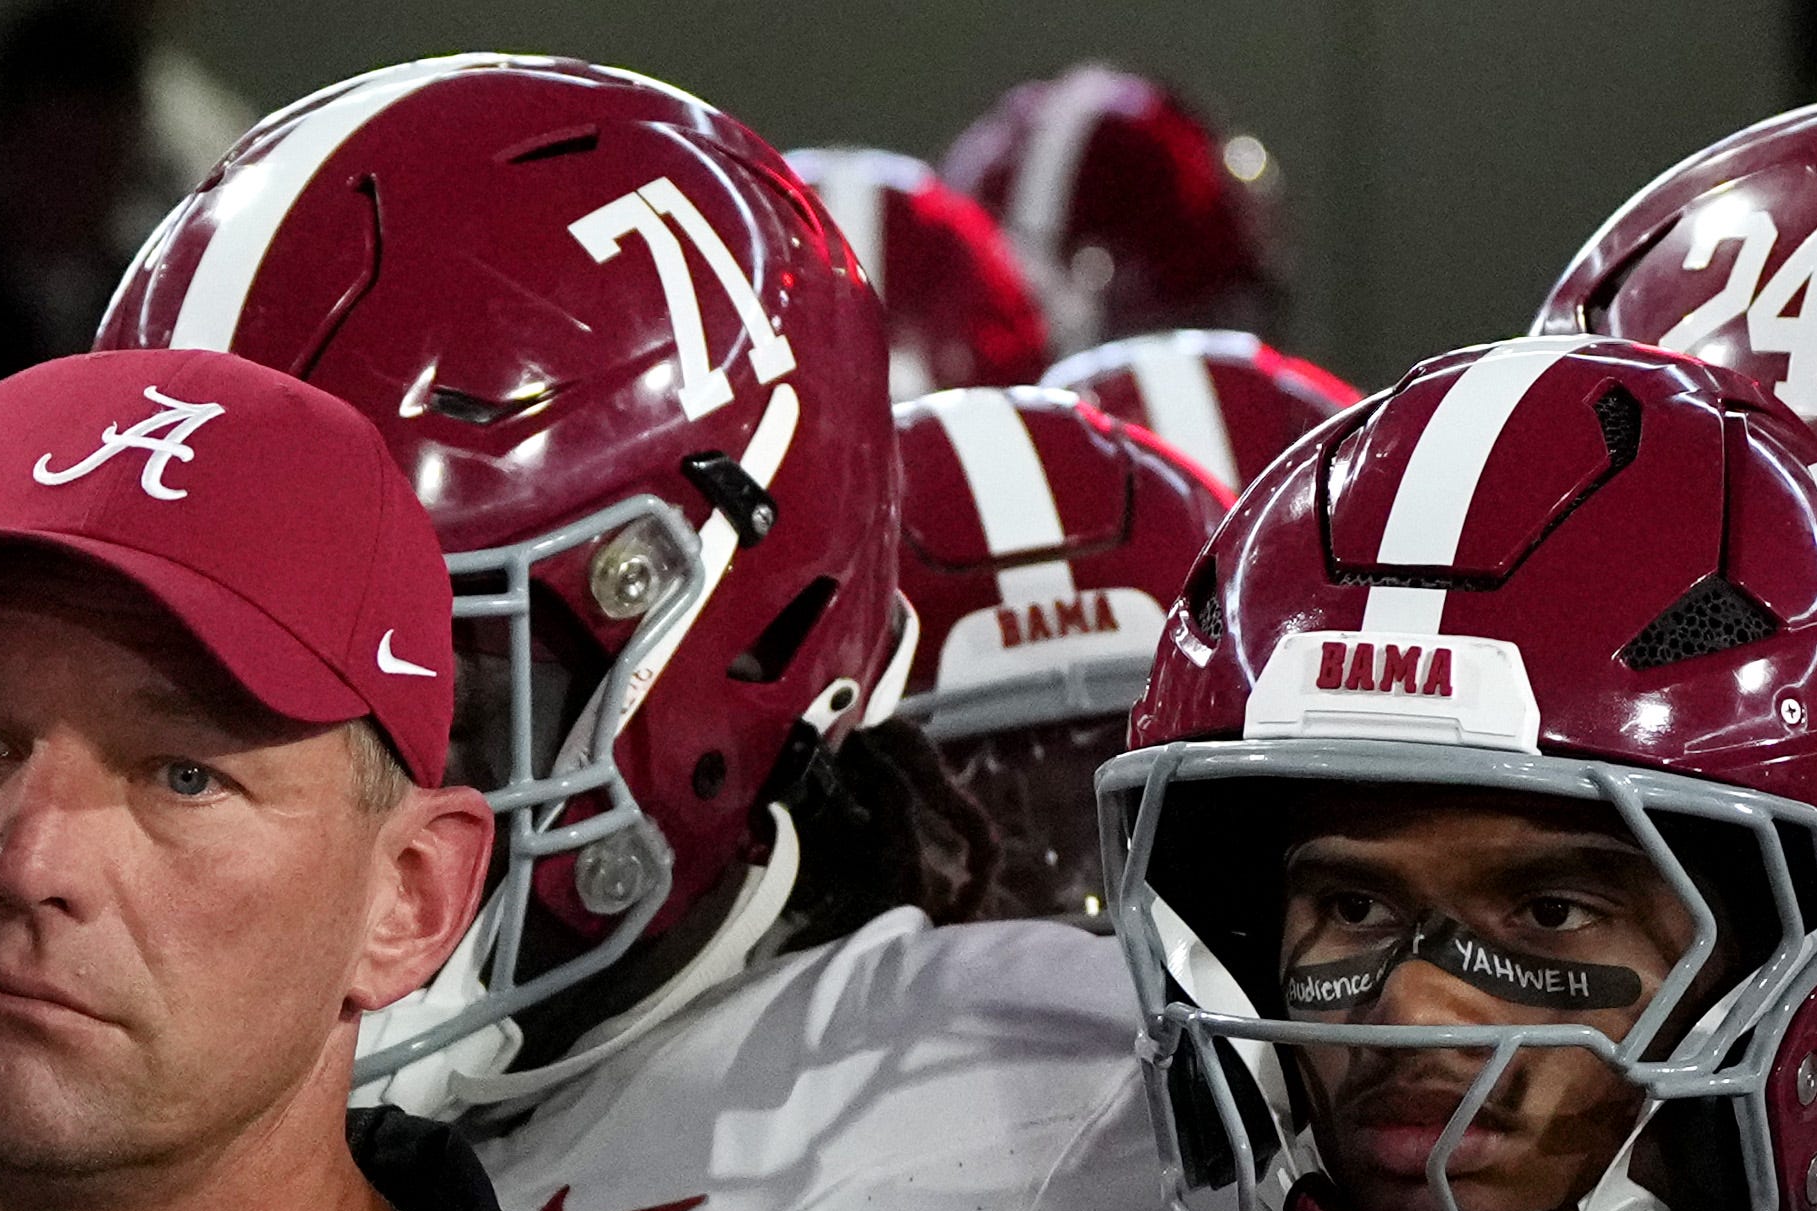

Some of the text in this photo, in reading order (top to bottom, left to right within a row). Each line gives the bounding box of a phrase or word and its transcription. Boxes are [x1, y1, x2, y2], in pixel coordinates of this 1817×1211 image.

[567, 176, 797, 422] 71
[1658, 209, 1817, 417] 24
[32, 385, 226, 501] A
[997, 592, 1120, 649] BAMA
[1316, 641, 1453, 697] BAMA
[1454, 938, 1590, 997] YAHWEH
